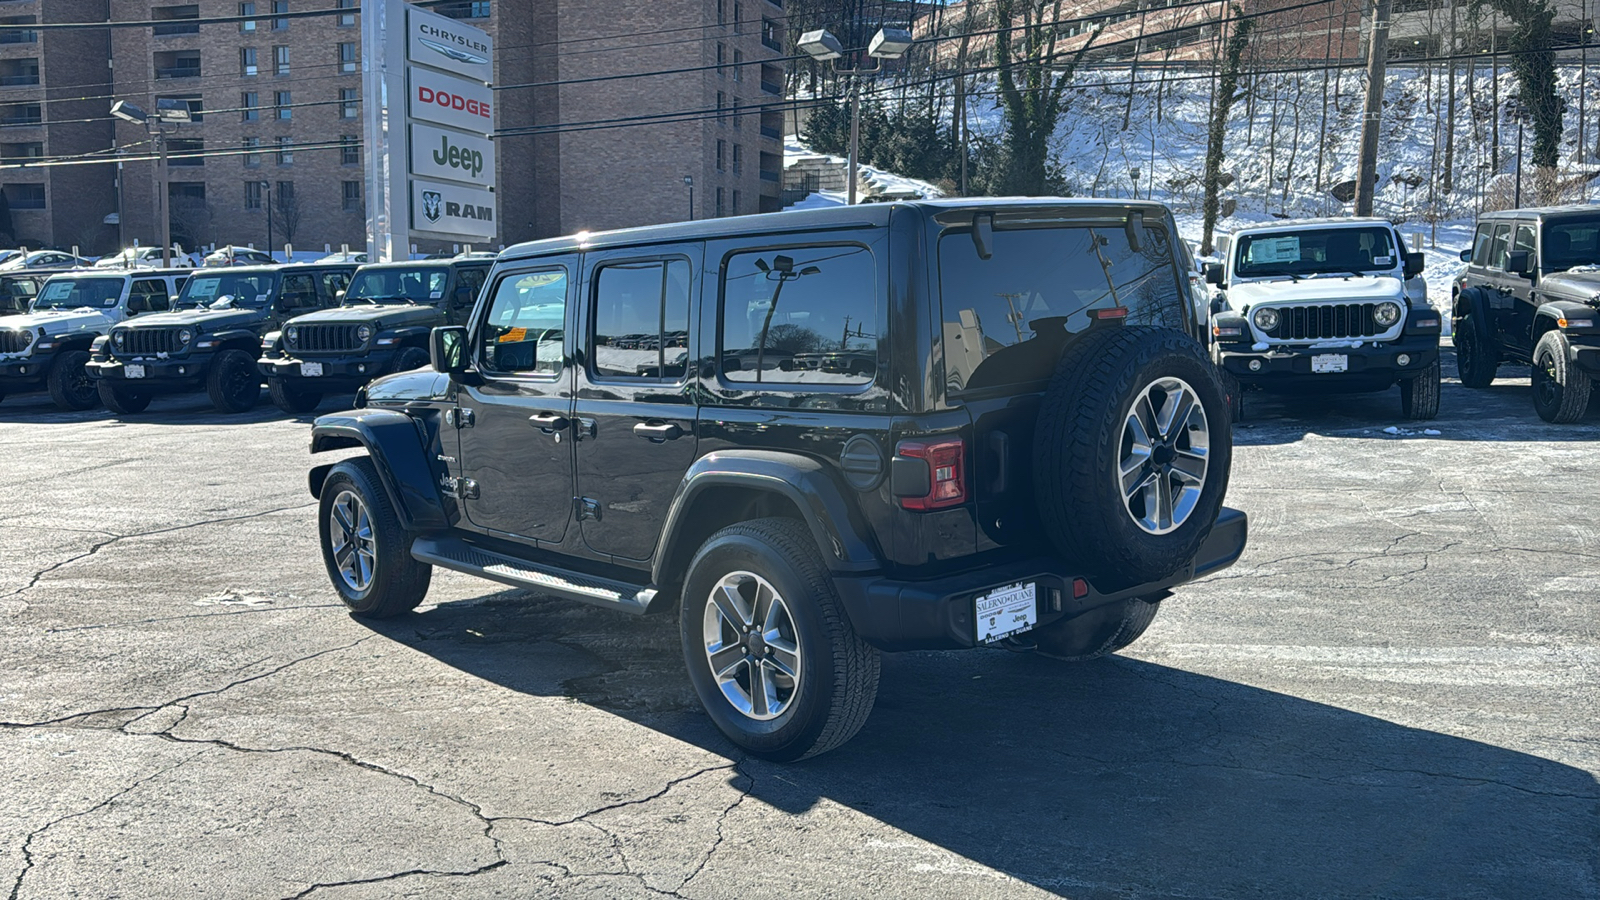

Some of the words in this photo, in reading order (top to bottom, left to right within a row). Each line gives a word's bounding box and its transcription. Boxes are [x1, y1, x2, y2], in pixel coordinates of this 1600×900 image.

[420, 24, 488, 54] CHRYSLER
[418, 86, 491, 118] DODGE
[433, 135, 483, 178] Jeep
[445, 201, 493, 221] RAM
[440, 473, 458, 491] Jeep
[1012, 614, 1027, 623] Jeep
